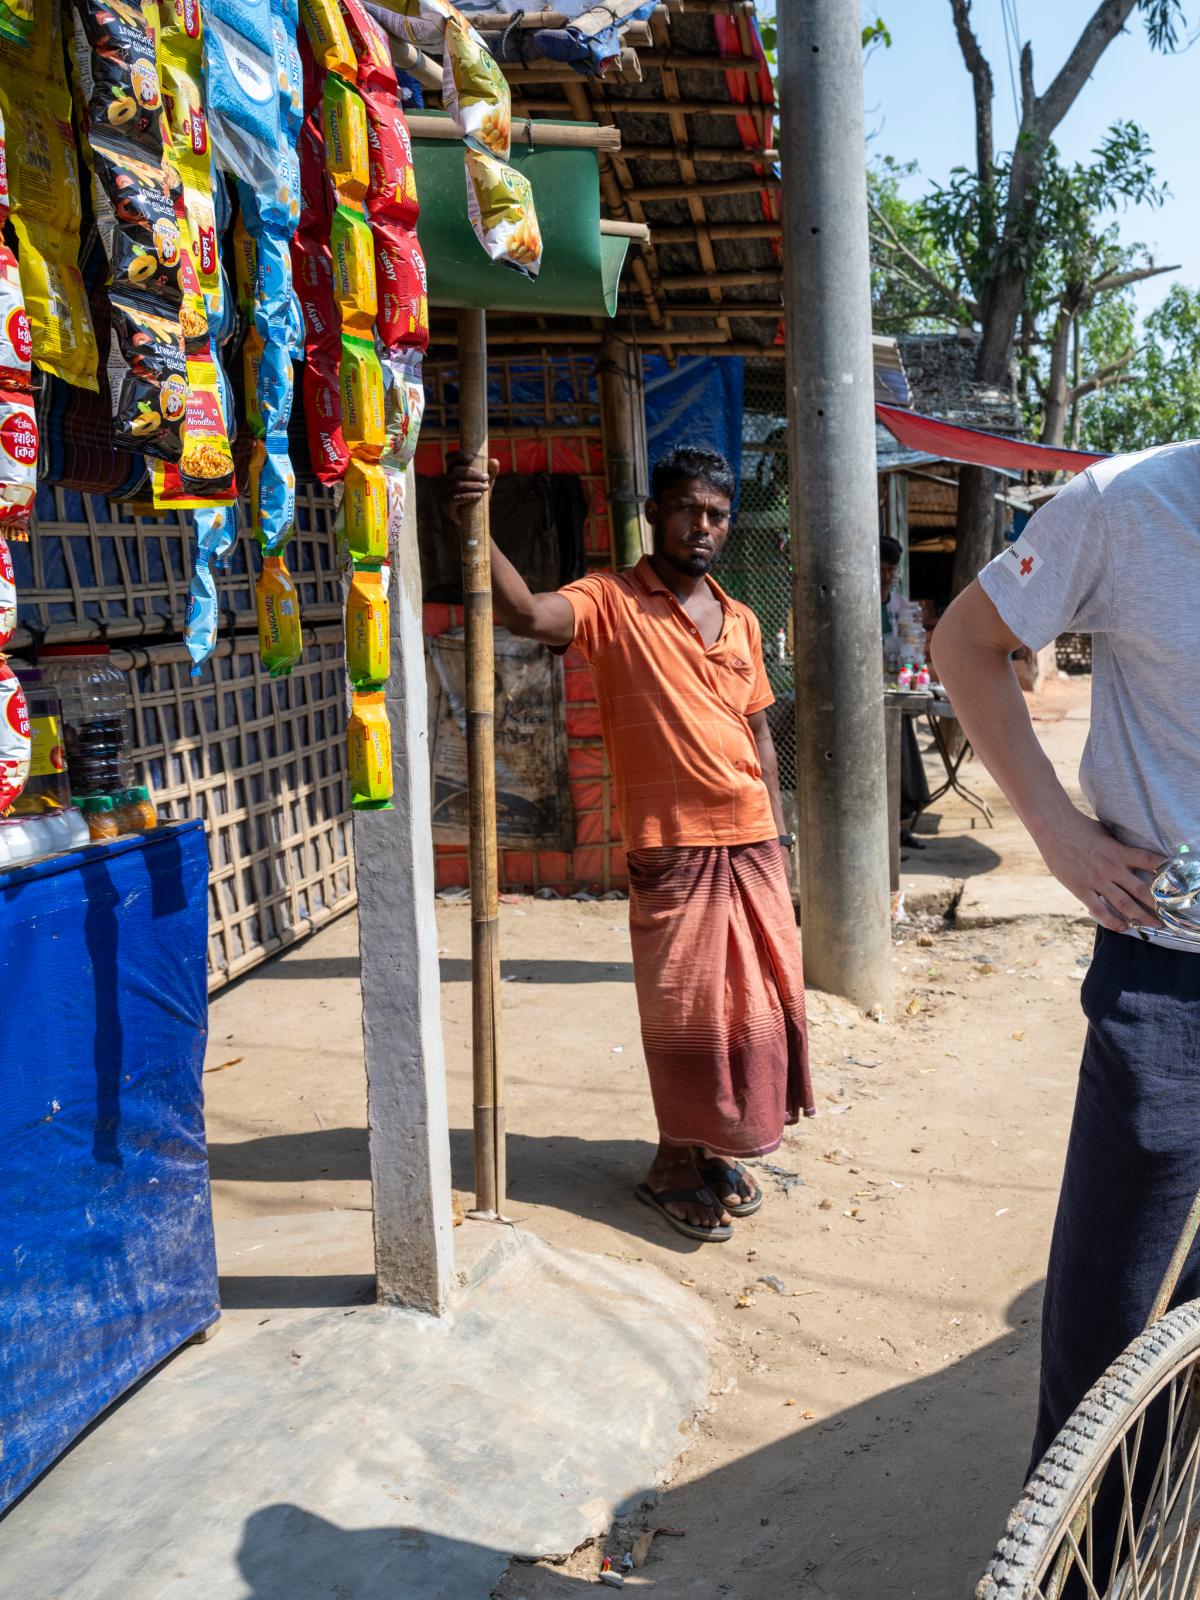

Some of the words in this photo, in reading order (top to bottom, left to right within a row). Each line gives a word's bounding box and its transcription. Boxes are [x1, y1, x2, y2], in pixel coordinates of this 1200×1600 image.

[379, 248, 397, 282] Tastyy
[343, 373, 357, 426] MANGOMEE
[187, 417, 217, 426] Noodles
[15, 446, 35, 459] কেক
[320, 431, 339, 463] Tastyy
[265, 593, 280, 645] MANGOMEE
